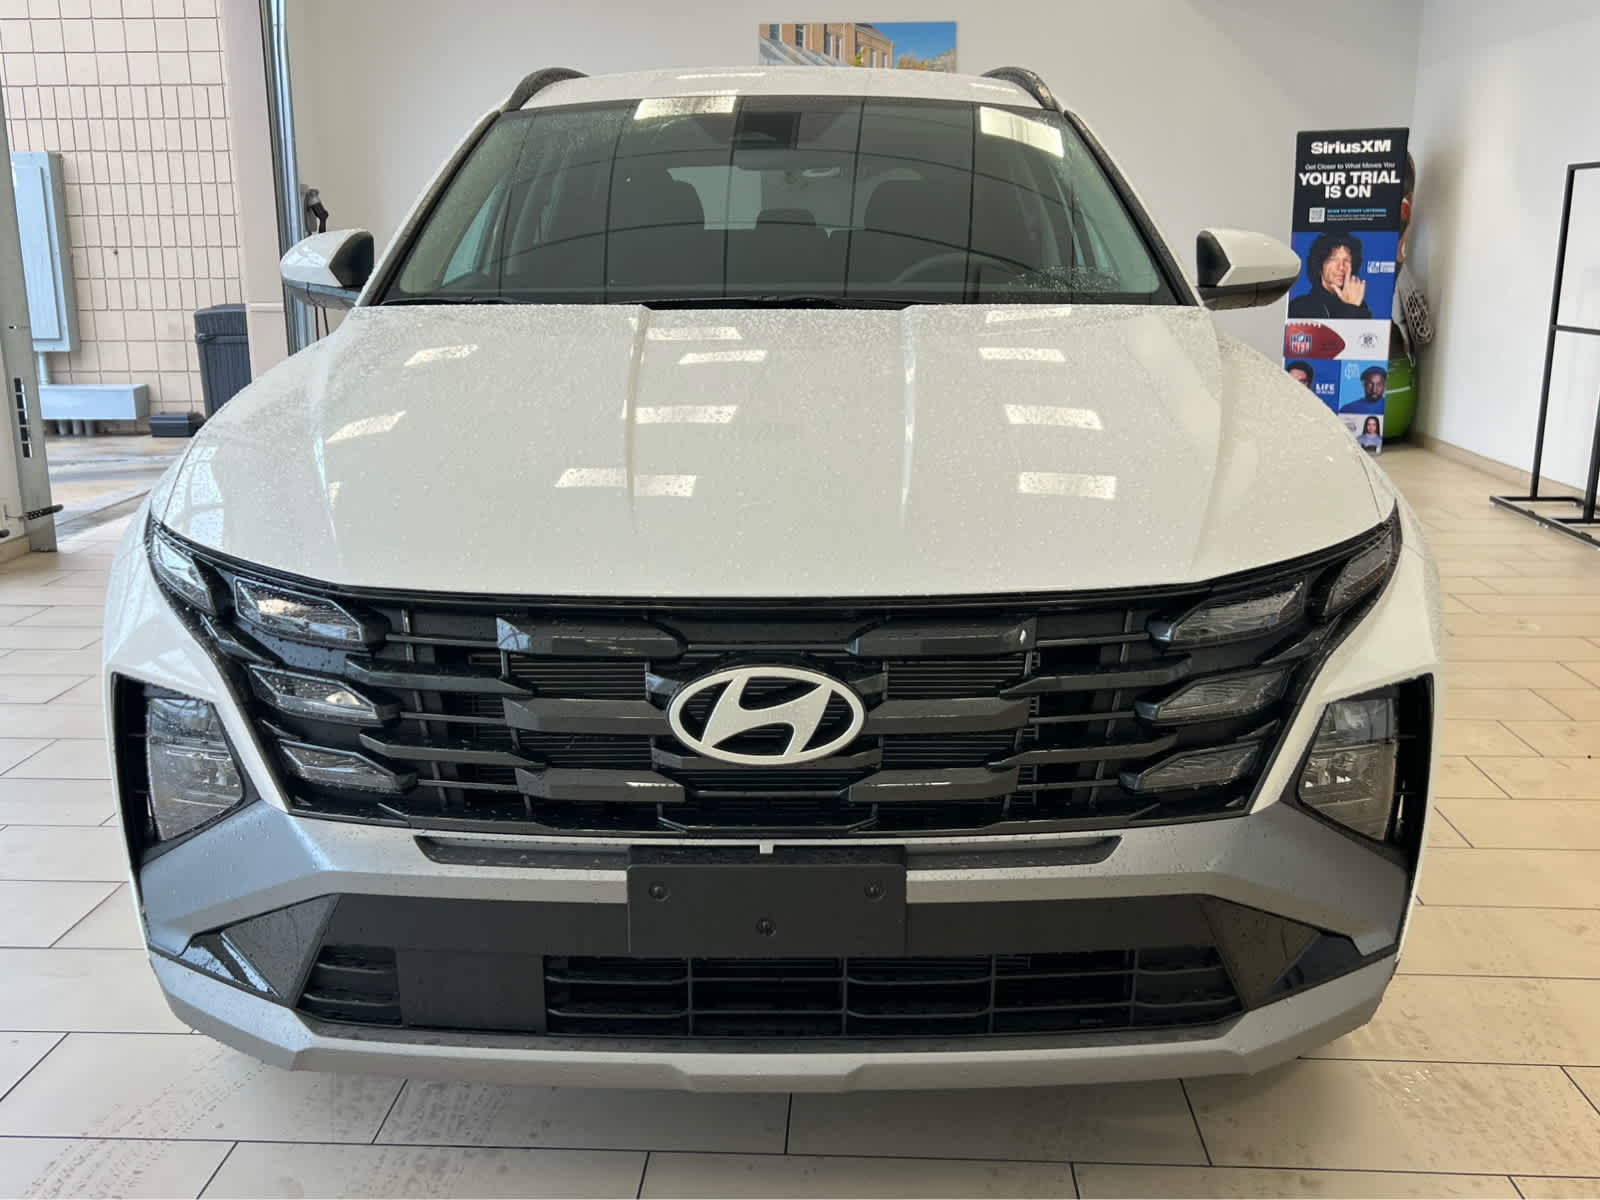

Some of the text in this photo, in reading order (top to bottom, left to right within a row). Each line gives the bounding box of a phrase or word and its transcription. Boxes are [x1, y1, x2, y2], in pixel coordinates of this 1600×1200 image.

[1311, 139, 1391, 154] SiriusXM
[1299, 170, 1400, 186] YOUR TRIAL
[1325, 184, 1371, 199] IS ON
